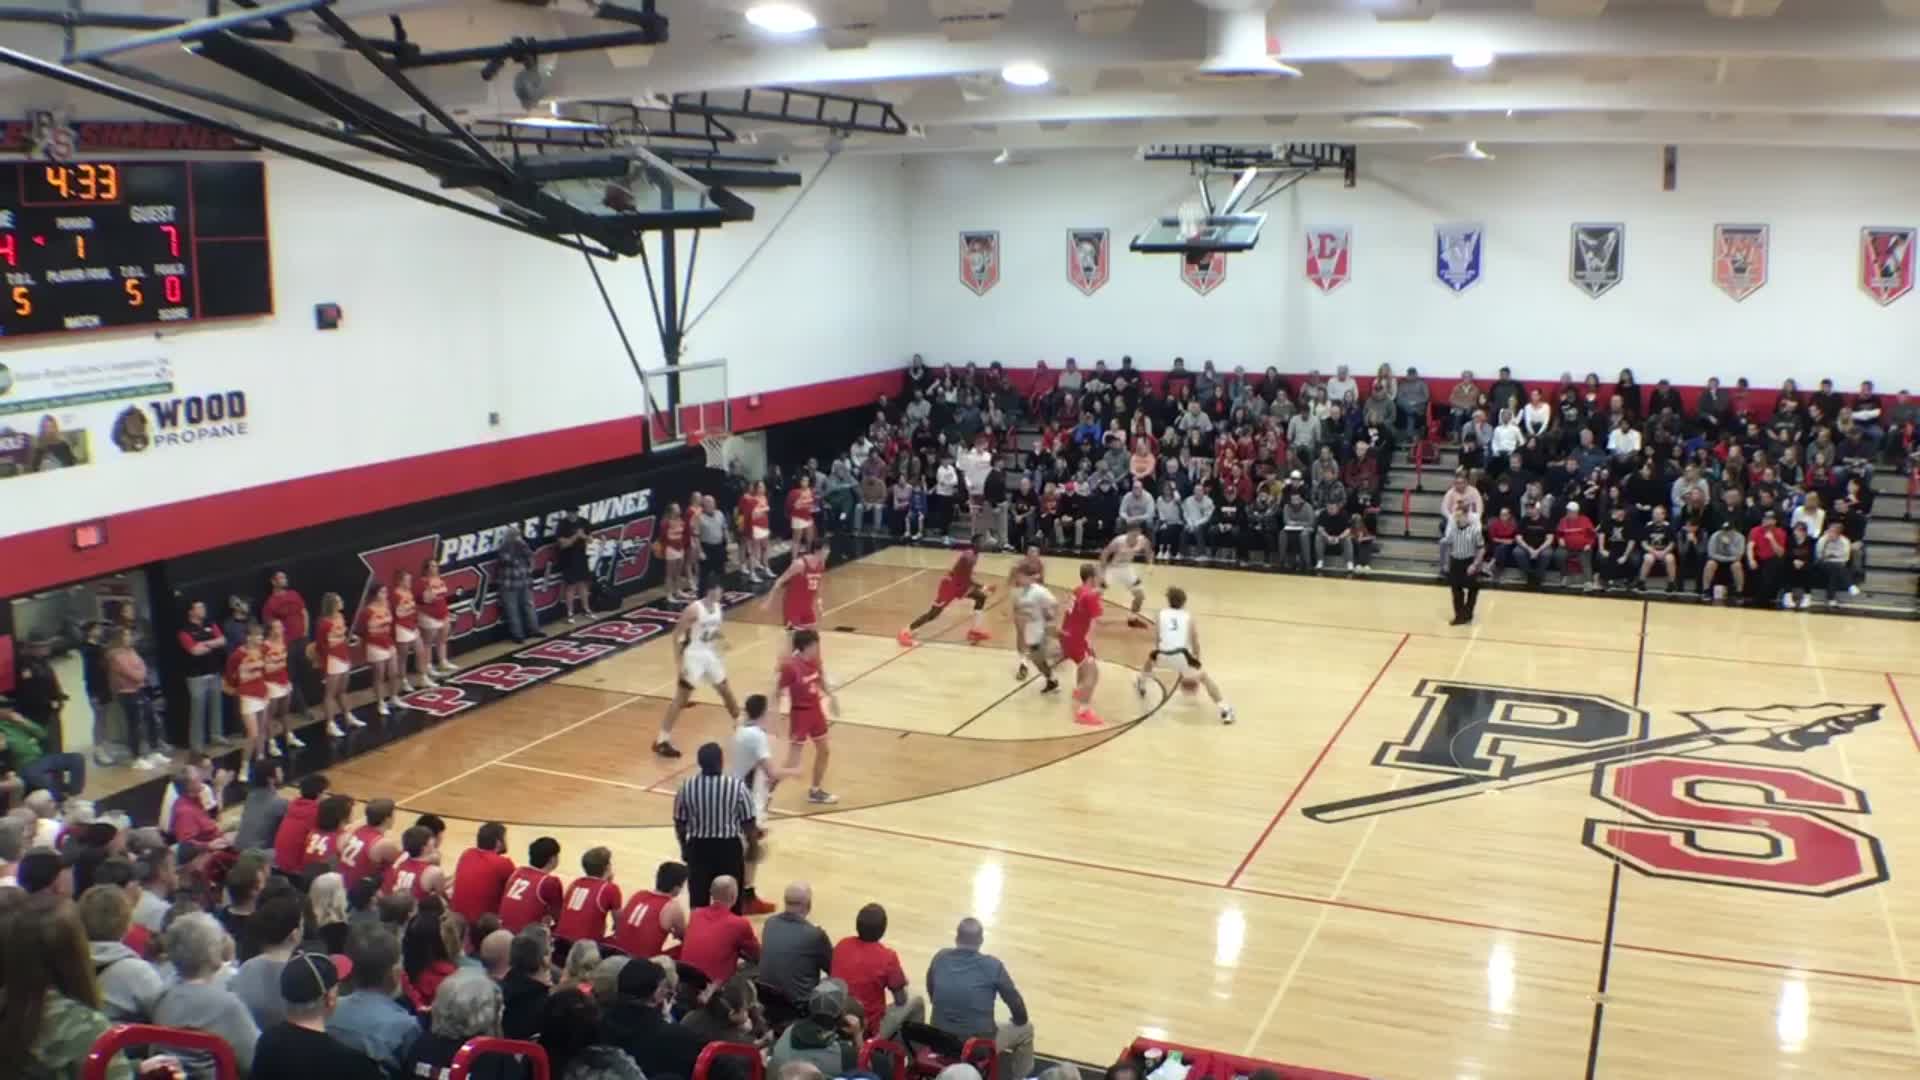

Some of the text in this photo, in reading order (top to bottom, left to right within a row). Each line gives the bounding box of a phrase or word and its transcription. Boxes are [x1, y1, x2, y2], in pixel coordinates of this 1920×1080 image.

[46, 164, 118, 199] 4:33
[130, 205, 176, 223] GUEST
[76, 235, 85, 259] 1
[159, 225, 180, 257] 7
[12, 286, 32, 316] 5
[125, 278, 143, 306] 5
[164, 276, 182, 303] 0
[151, 390, 247, 428] WOOD
[154, 422, 249, 448] PROPANE
[1167, 616, 1179, 632] 3
[507, 878, 531, 900] 12
[627, 903, 649, 928] 11
